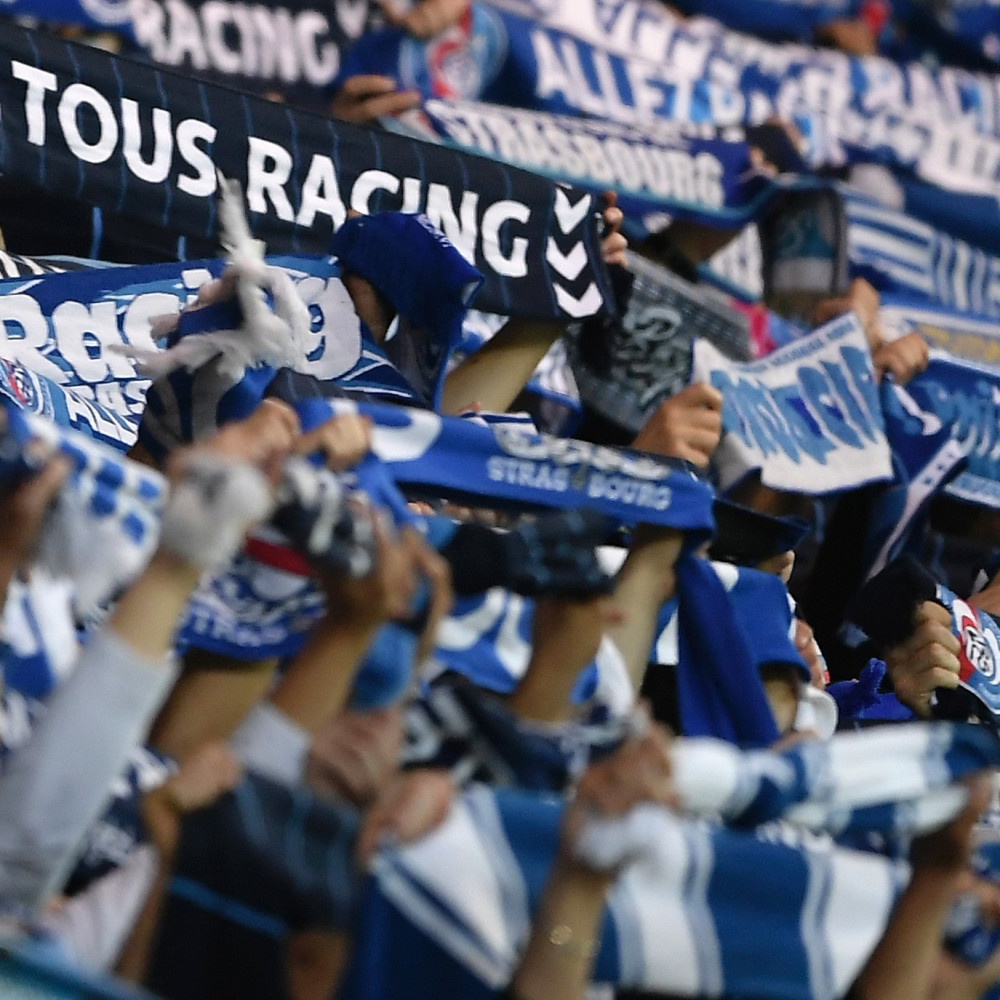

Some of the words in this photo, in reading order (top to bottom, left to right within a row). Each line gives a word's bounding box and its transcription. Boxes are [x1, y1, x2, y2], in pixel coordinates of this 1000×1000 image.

[11, 60, 219, 198] TOUS
[443, 106, 727, 208] STRASBOURG
[486, 455, 569, 493] STRAS
